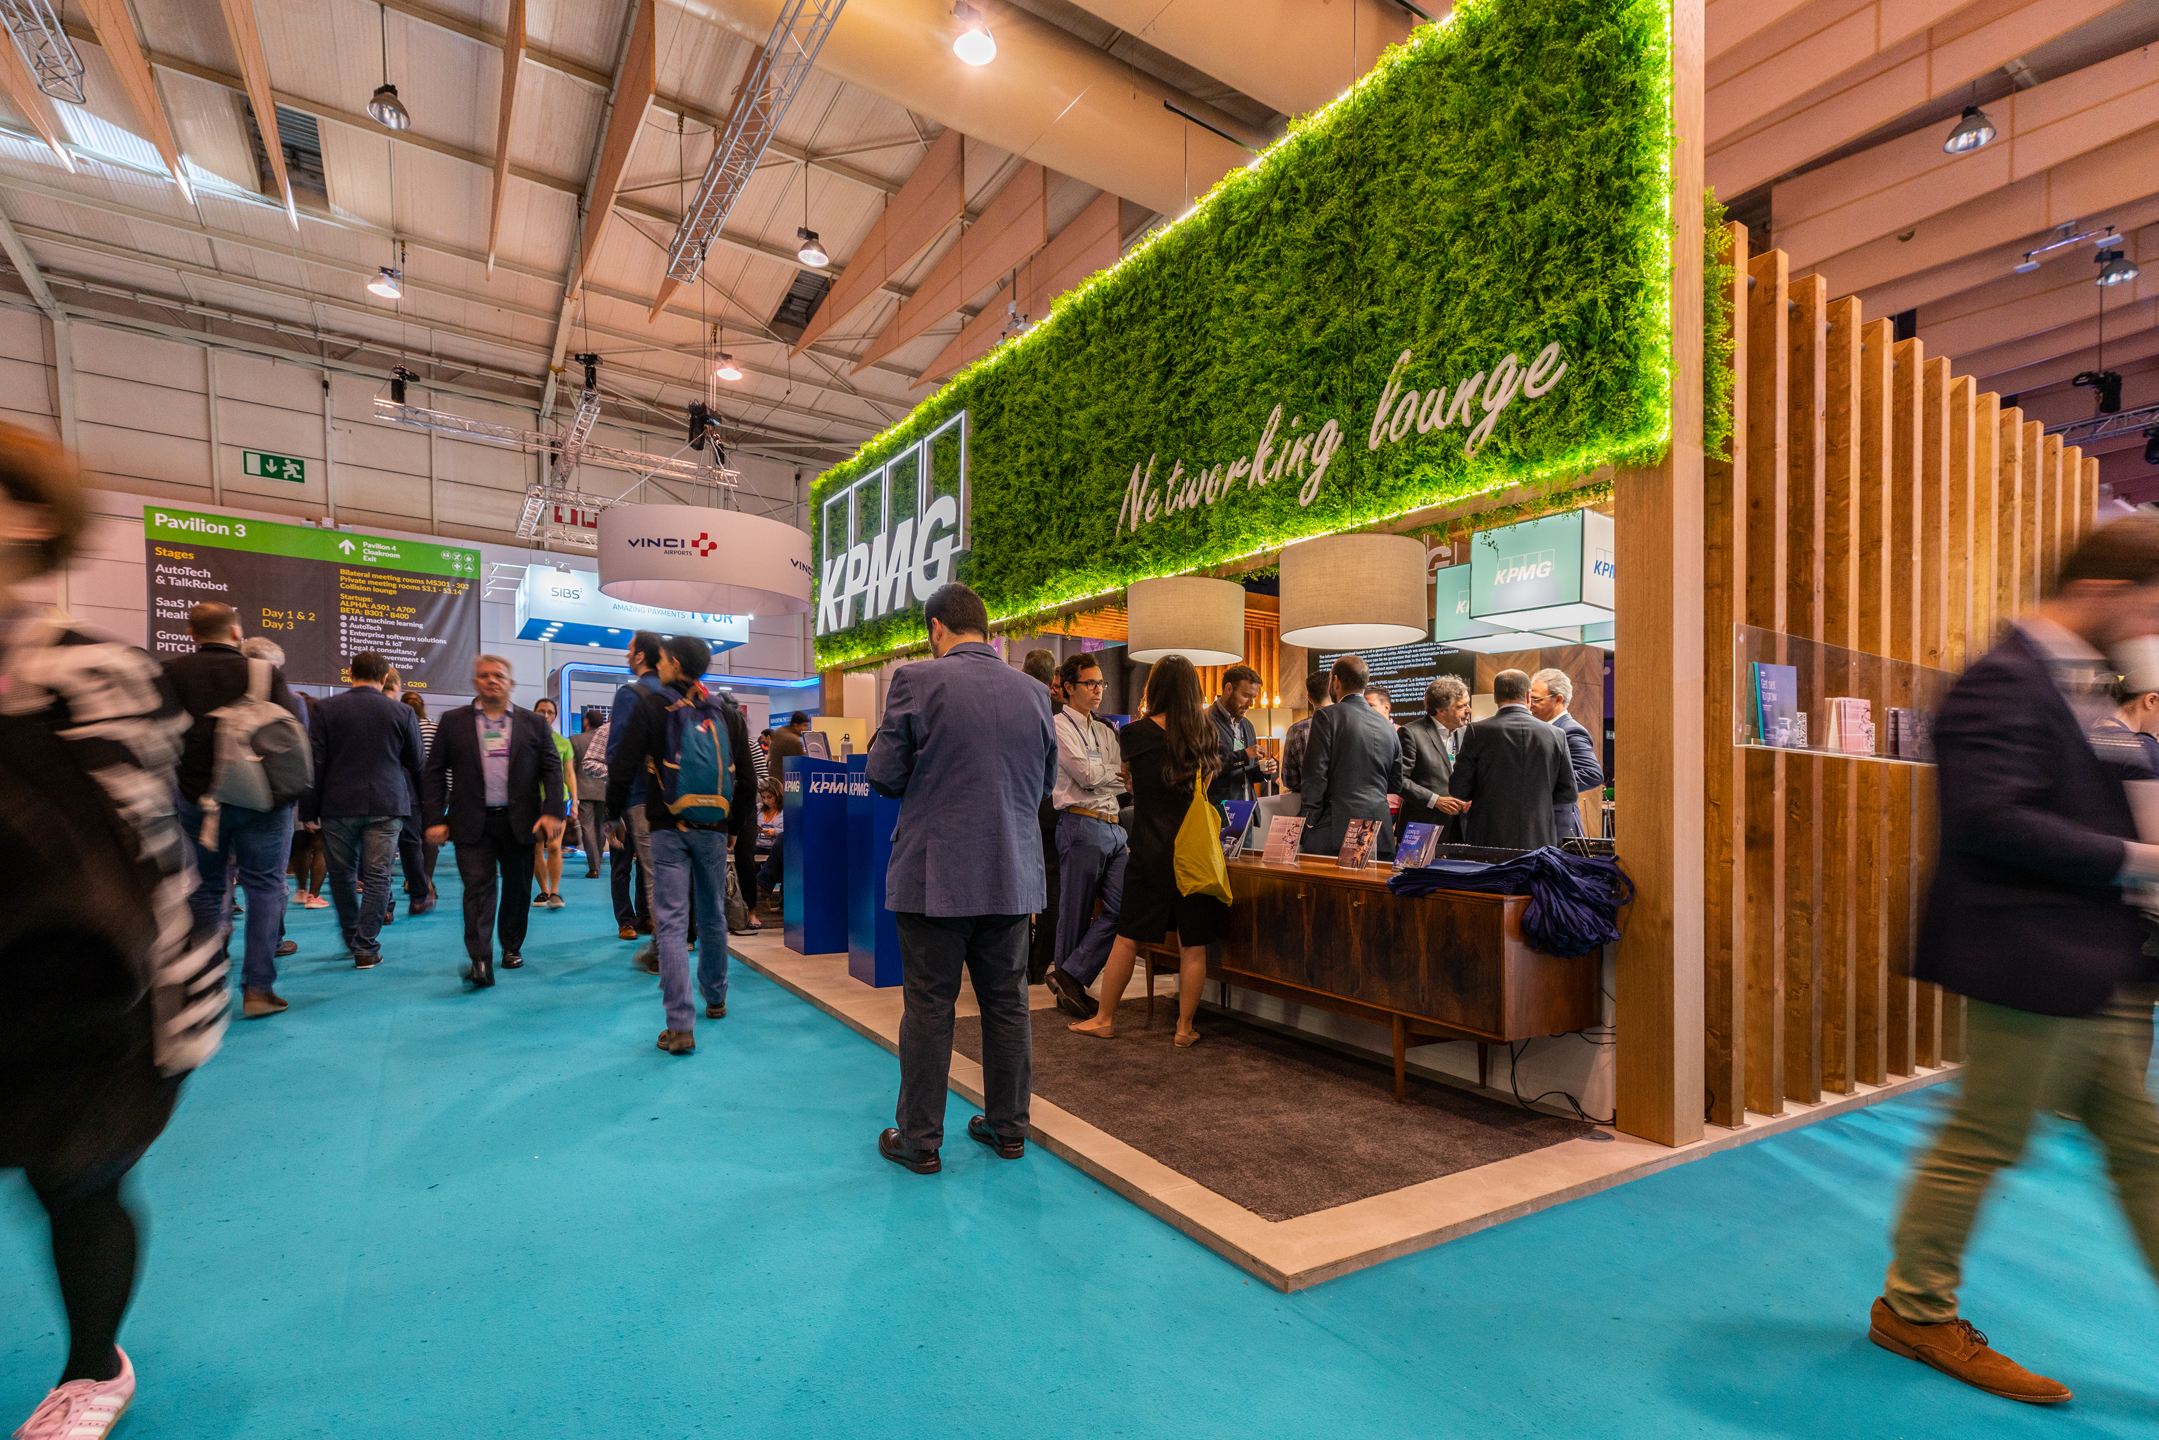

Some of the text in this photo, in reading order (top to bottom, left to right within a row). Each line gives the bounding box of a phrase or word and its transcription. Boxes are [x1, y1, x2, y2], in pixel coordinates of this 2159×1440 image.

[1115, 341, 1568, 536] Networking lounge
[154, 513, 246, 537] Pavilion 3
[363, 542, 390, 551] Pavilion
[628, 538, 685, 548] VINCI
[155, 546, 194, 560] Stages
[363, 548, 400, 559] Cloakroom
[155, 564, 211, 578] AutoTech
[791, 558, 812, 576] VINC
[816, 495, 956, 637] KPMG
[340, 569, 370, 578] Bilateral
[372, 573, 401, 583] meeting
[1494, 561, 1552, 586] KPMG
[156, 575, 228, 591] & TalkRobot
[340, 576, 366, 584] Private
[368, 580, 397, 589] meeting
[340, 583, 397, 595] Collision lounge
[156, 597, 185, 608] SaaS
[340, 593, 373, 602] Startups:
[340, 600, 369, 609] ALPHA:
[156, 608, 190, 620] Healt
[262, 608, 284, 619] Day
[296, 612, 305, 620] &
[308, 612, 316, 621] 2
[612, 604, 686, 619] AMAZING PAYMENTS
[262, 619, 294, 630] Day 3
[349, 623, 382, 631] AutoTech
[396, 620, 423, 629] learning
[156, 630, 195, 642] Growt
[350, 630, 385, 639] Enterprise
[156, 642, 196, 653] PITCH
[350, 637, 384, 646] Hardware
[350, 644, 368, 652] Legal
[376, 647, 417, 656] consultancy
[784, 780, 800, 792] KPMG
[809, 781, 847, 794] KPM
[849, 783, 869, 796] KPMG
